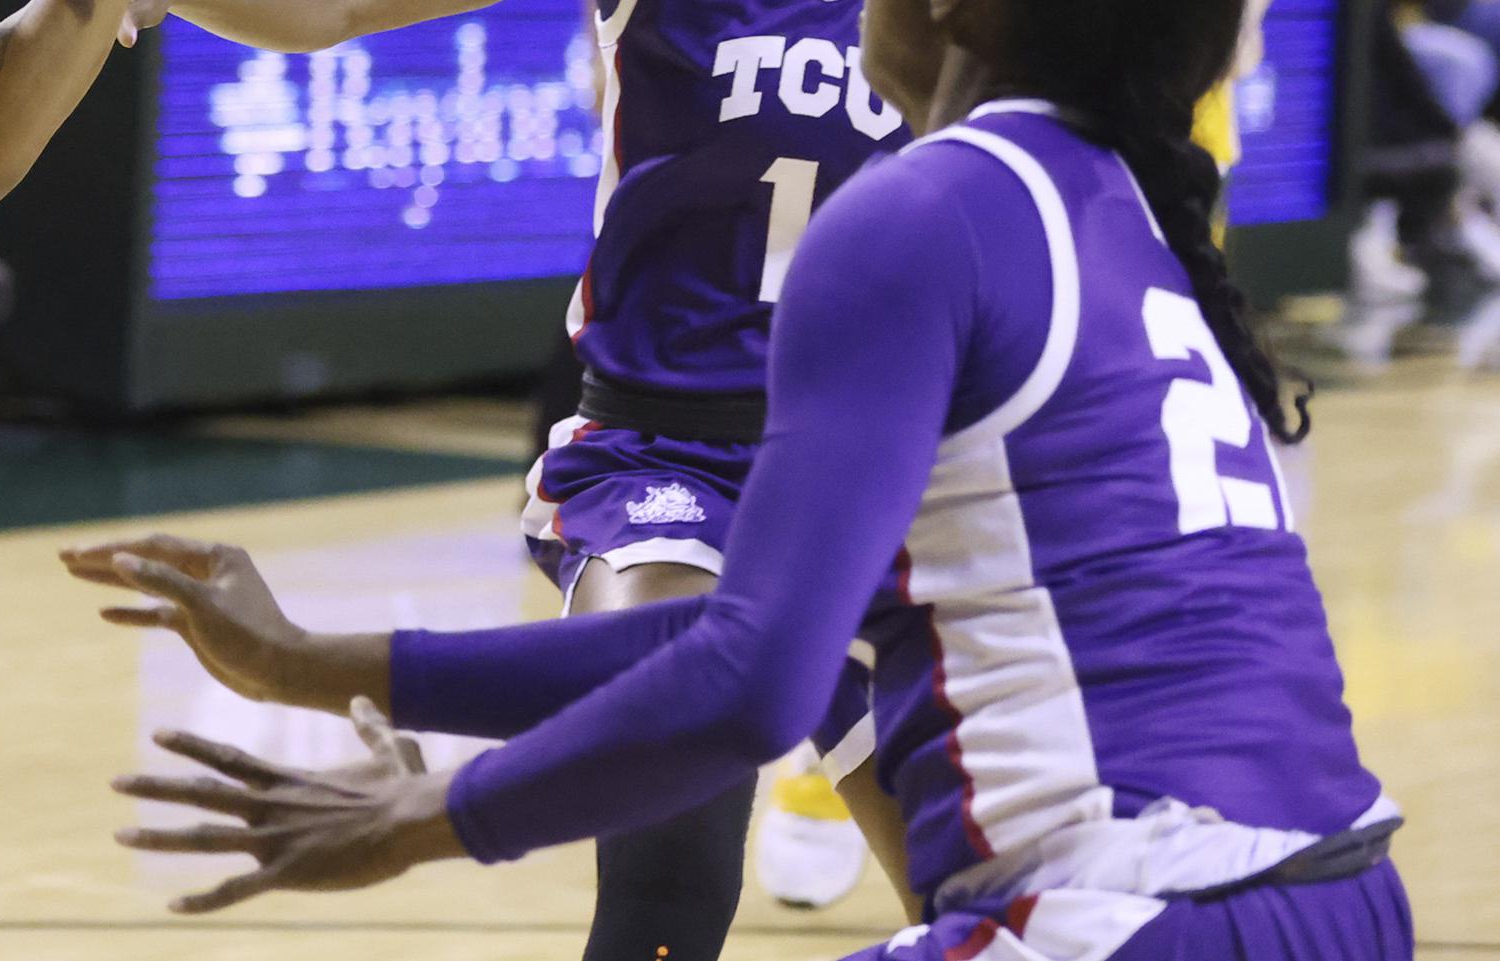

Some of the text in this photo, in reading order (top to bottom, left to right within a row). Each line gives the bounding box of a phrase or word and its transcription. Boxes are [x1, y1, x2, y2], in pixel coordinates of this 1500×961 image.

[712, 35, 903, 141] TCU
[759, 156, 820, 303] 1
[1141, 286, 1294, 535] 2
